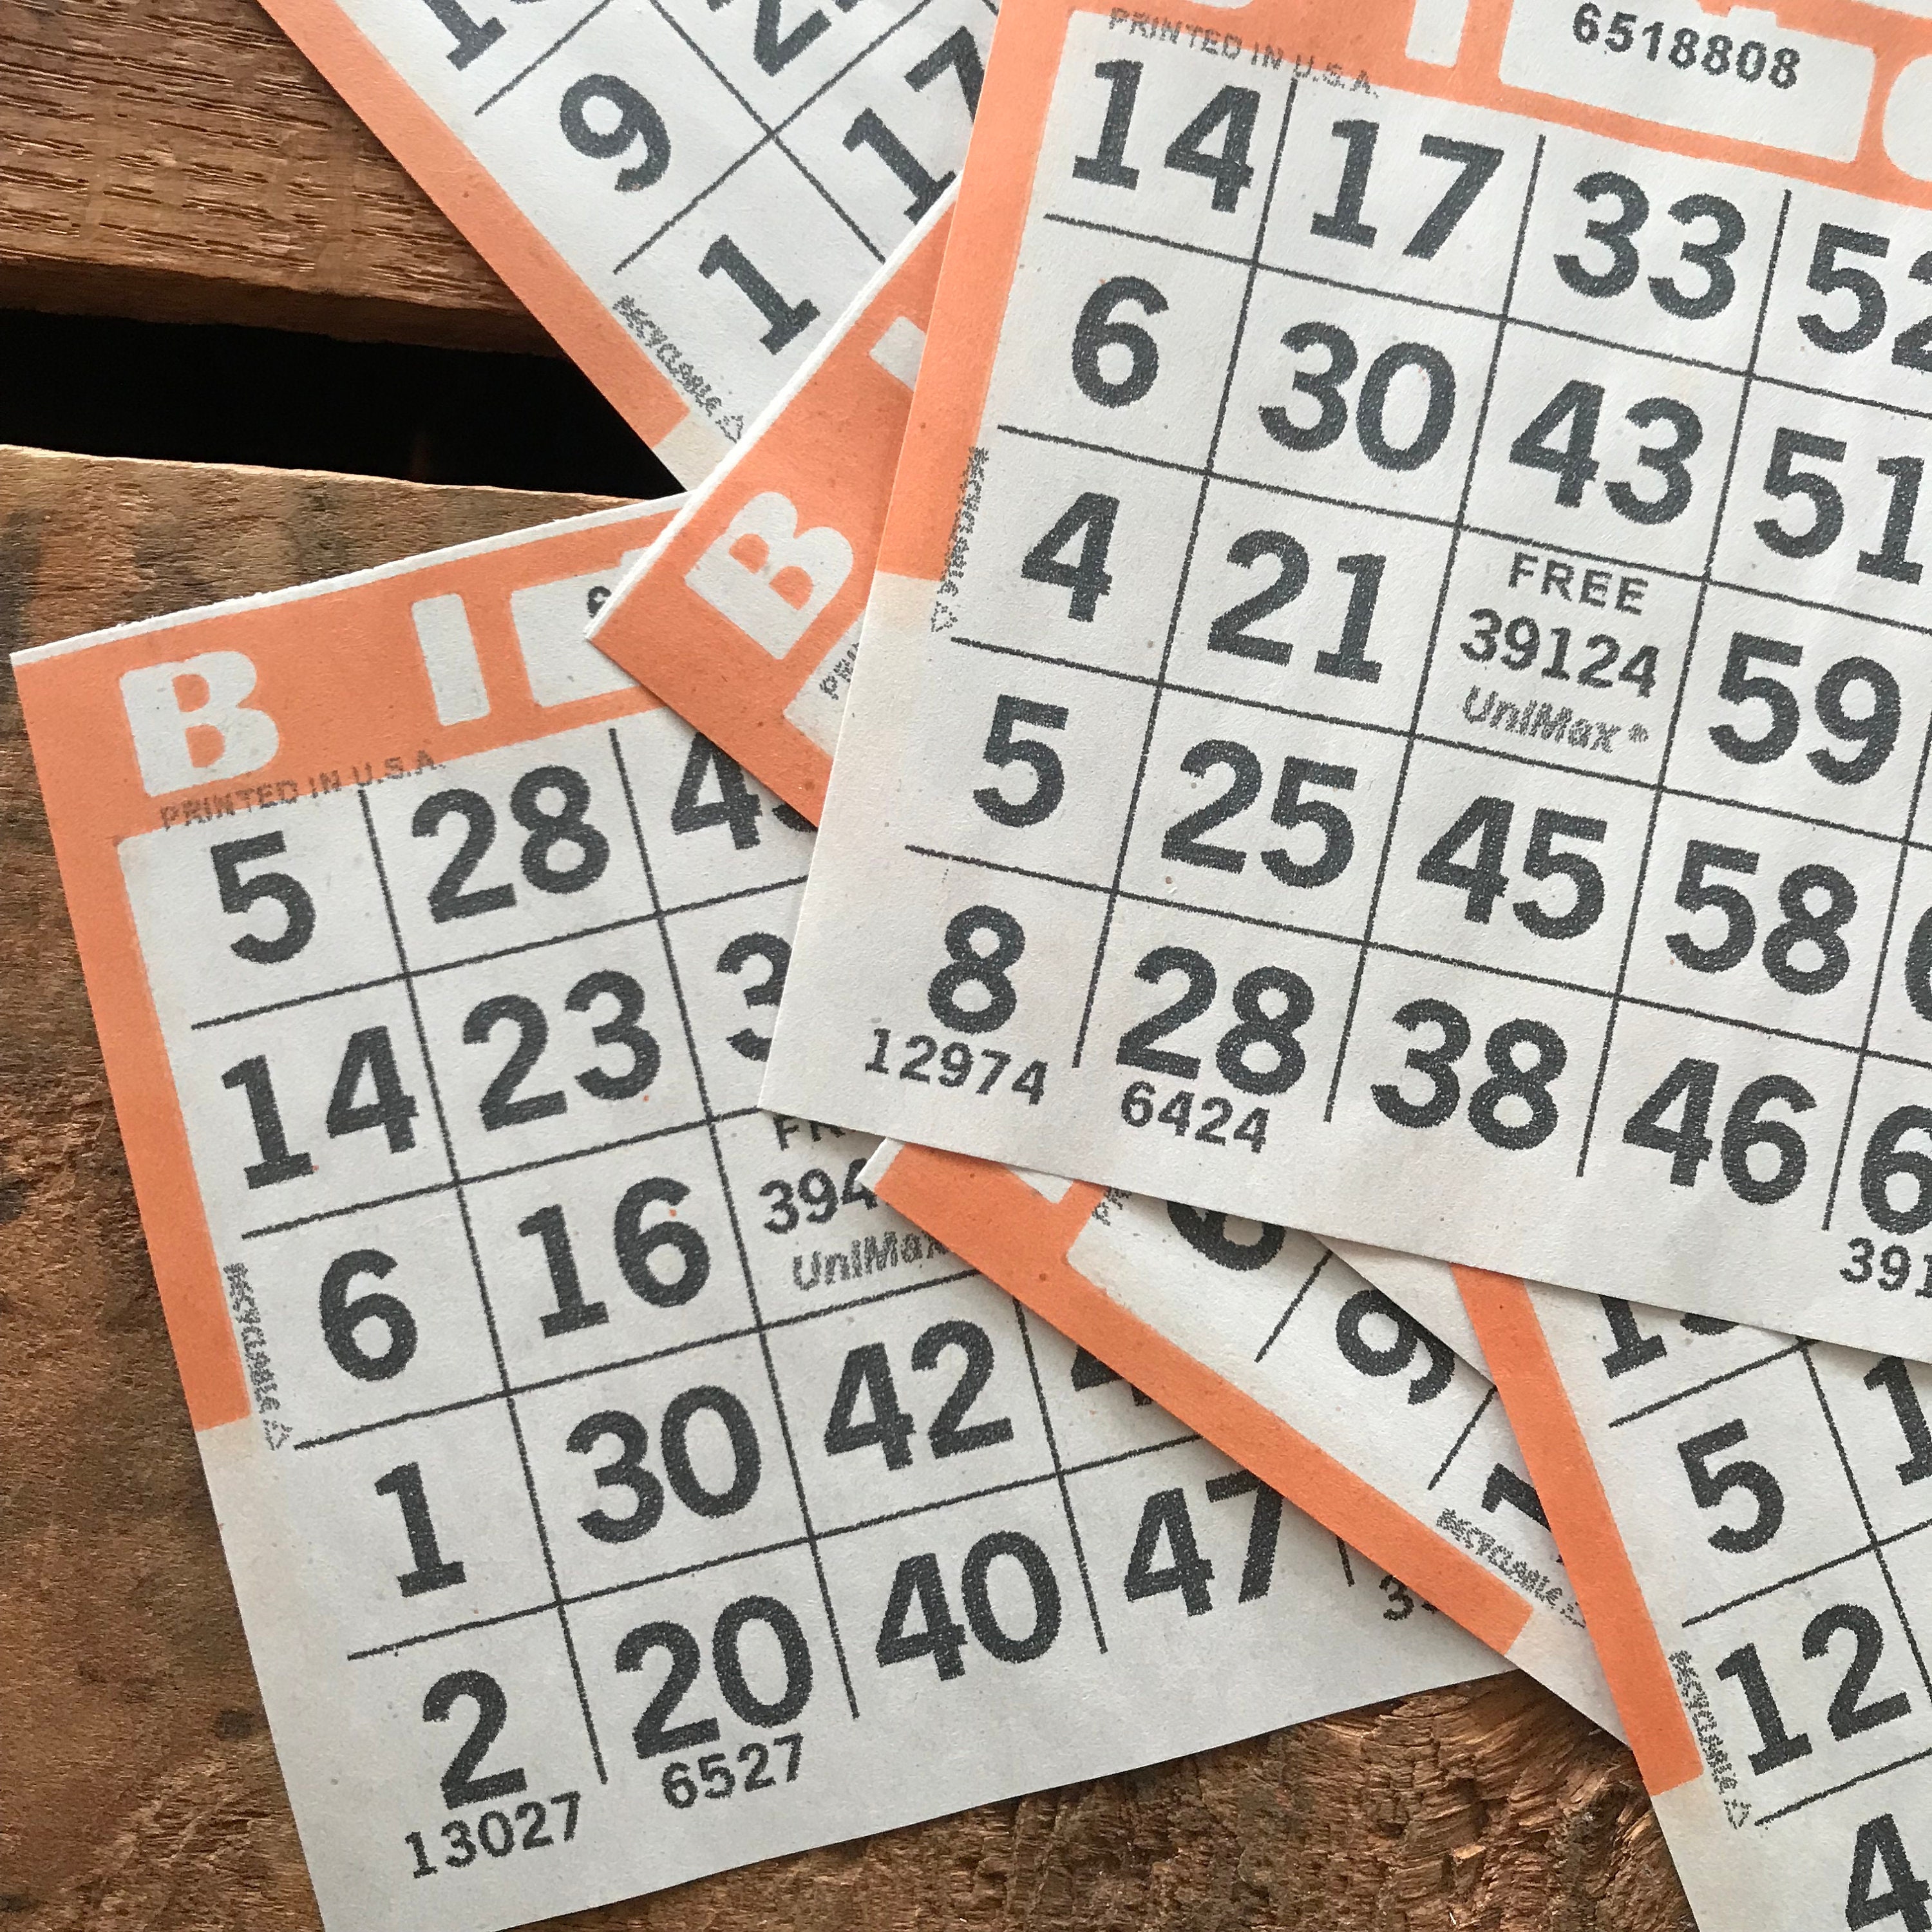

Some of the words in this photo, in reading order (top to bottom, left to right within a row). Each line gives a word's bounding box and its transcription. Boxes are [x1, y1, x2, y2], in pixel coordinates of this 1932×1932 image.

[1109, 7, 1242, 60] PRINTED
[1251, 41, 1284, 71] IN
[1293, 54, 1379, 99] U.S.A.
[1573, 2, 1800, 89] 6518808
[560, 74, 670, 191] 9
[1073, 59, 1260, 213] 14
[1311, 120, 1504, 260] 17
[699, 235, 820, 354] 1
[1554, 171, 1745, 320] 33
[1072, 276, 1168, 408] 6
[1258, 322, 1456, 472] 30
[1510, 380, 1703, 524] 43
[1754, 427, 1924, 585] 51
[683, 491, 854, 660] B
[1021, 492, 1120, 622] 4
[1208, 530, 1386, 683] 21
[1509, 552, 1648, 615] FREE
[118, 650, 280, 798] B
[410, 591, 491, 726] I
[1461, 609, 1659, 698] 39124
[1709, 632, 1901, 785] 59
[160, 778, 298, 831] PRINTED
[308, 769, 342, 799] IN
[351, 749, 446, 786] U.S.A.
[671, 732, 818, 850] 4
[973, 694, 1068, 828] 5
[1161, 739, 1357, 889] 25
[211, 831, 315, 964] 5
[412, 762, 609, 923] 28
[1417, 796, 1607, 940] 45
[927, 905, 1025, 1035] 8
[1666, 840, 1857, 995] 58
[463, 969, 661, 1132] 23
[866, 1028, 1048, 1105] 12974
[1115, 946, 1314, 1096] 28
[1370, 998, 1567, 1151] 38
[222, 1026, 419, 1189] 14
[1121, 1081, 1269, 1153] 6424
[1622, 1058, 1817, 1206] 46
[318, 1249, 417, 1381] 6
[518, 1177, 710, 1338] 16
[566, 1385, 761, 1544] 30
[824, 1320, 1014, 1471] 42
[375, 1462, 466, 1598] 1
[1124, 1470, 1283, 1616] 47
[1677, 1419, 1785, 1553] 5
[615, 1595, 813, 1759] 20
[875, 1531, 1062, 1681] 40
[422, 1669, 527, 1810] 2
[1716, 1604, 1911, 1776] 12
[404, 1791, 581, 1879] 13027
[661, 1732, 804, 1809] 6527
[1845, 1814, 1932, 1932] 4
